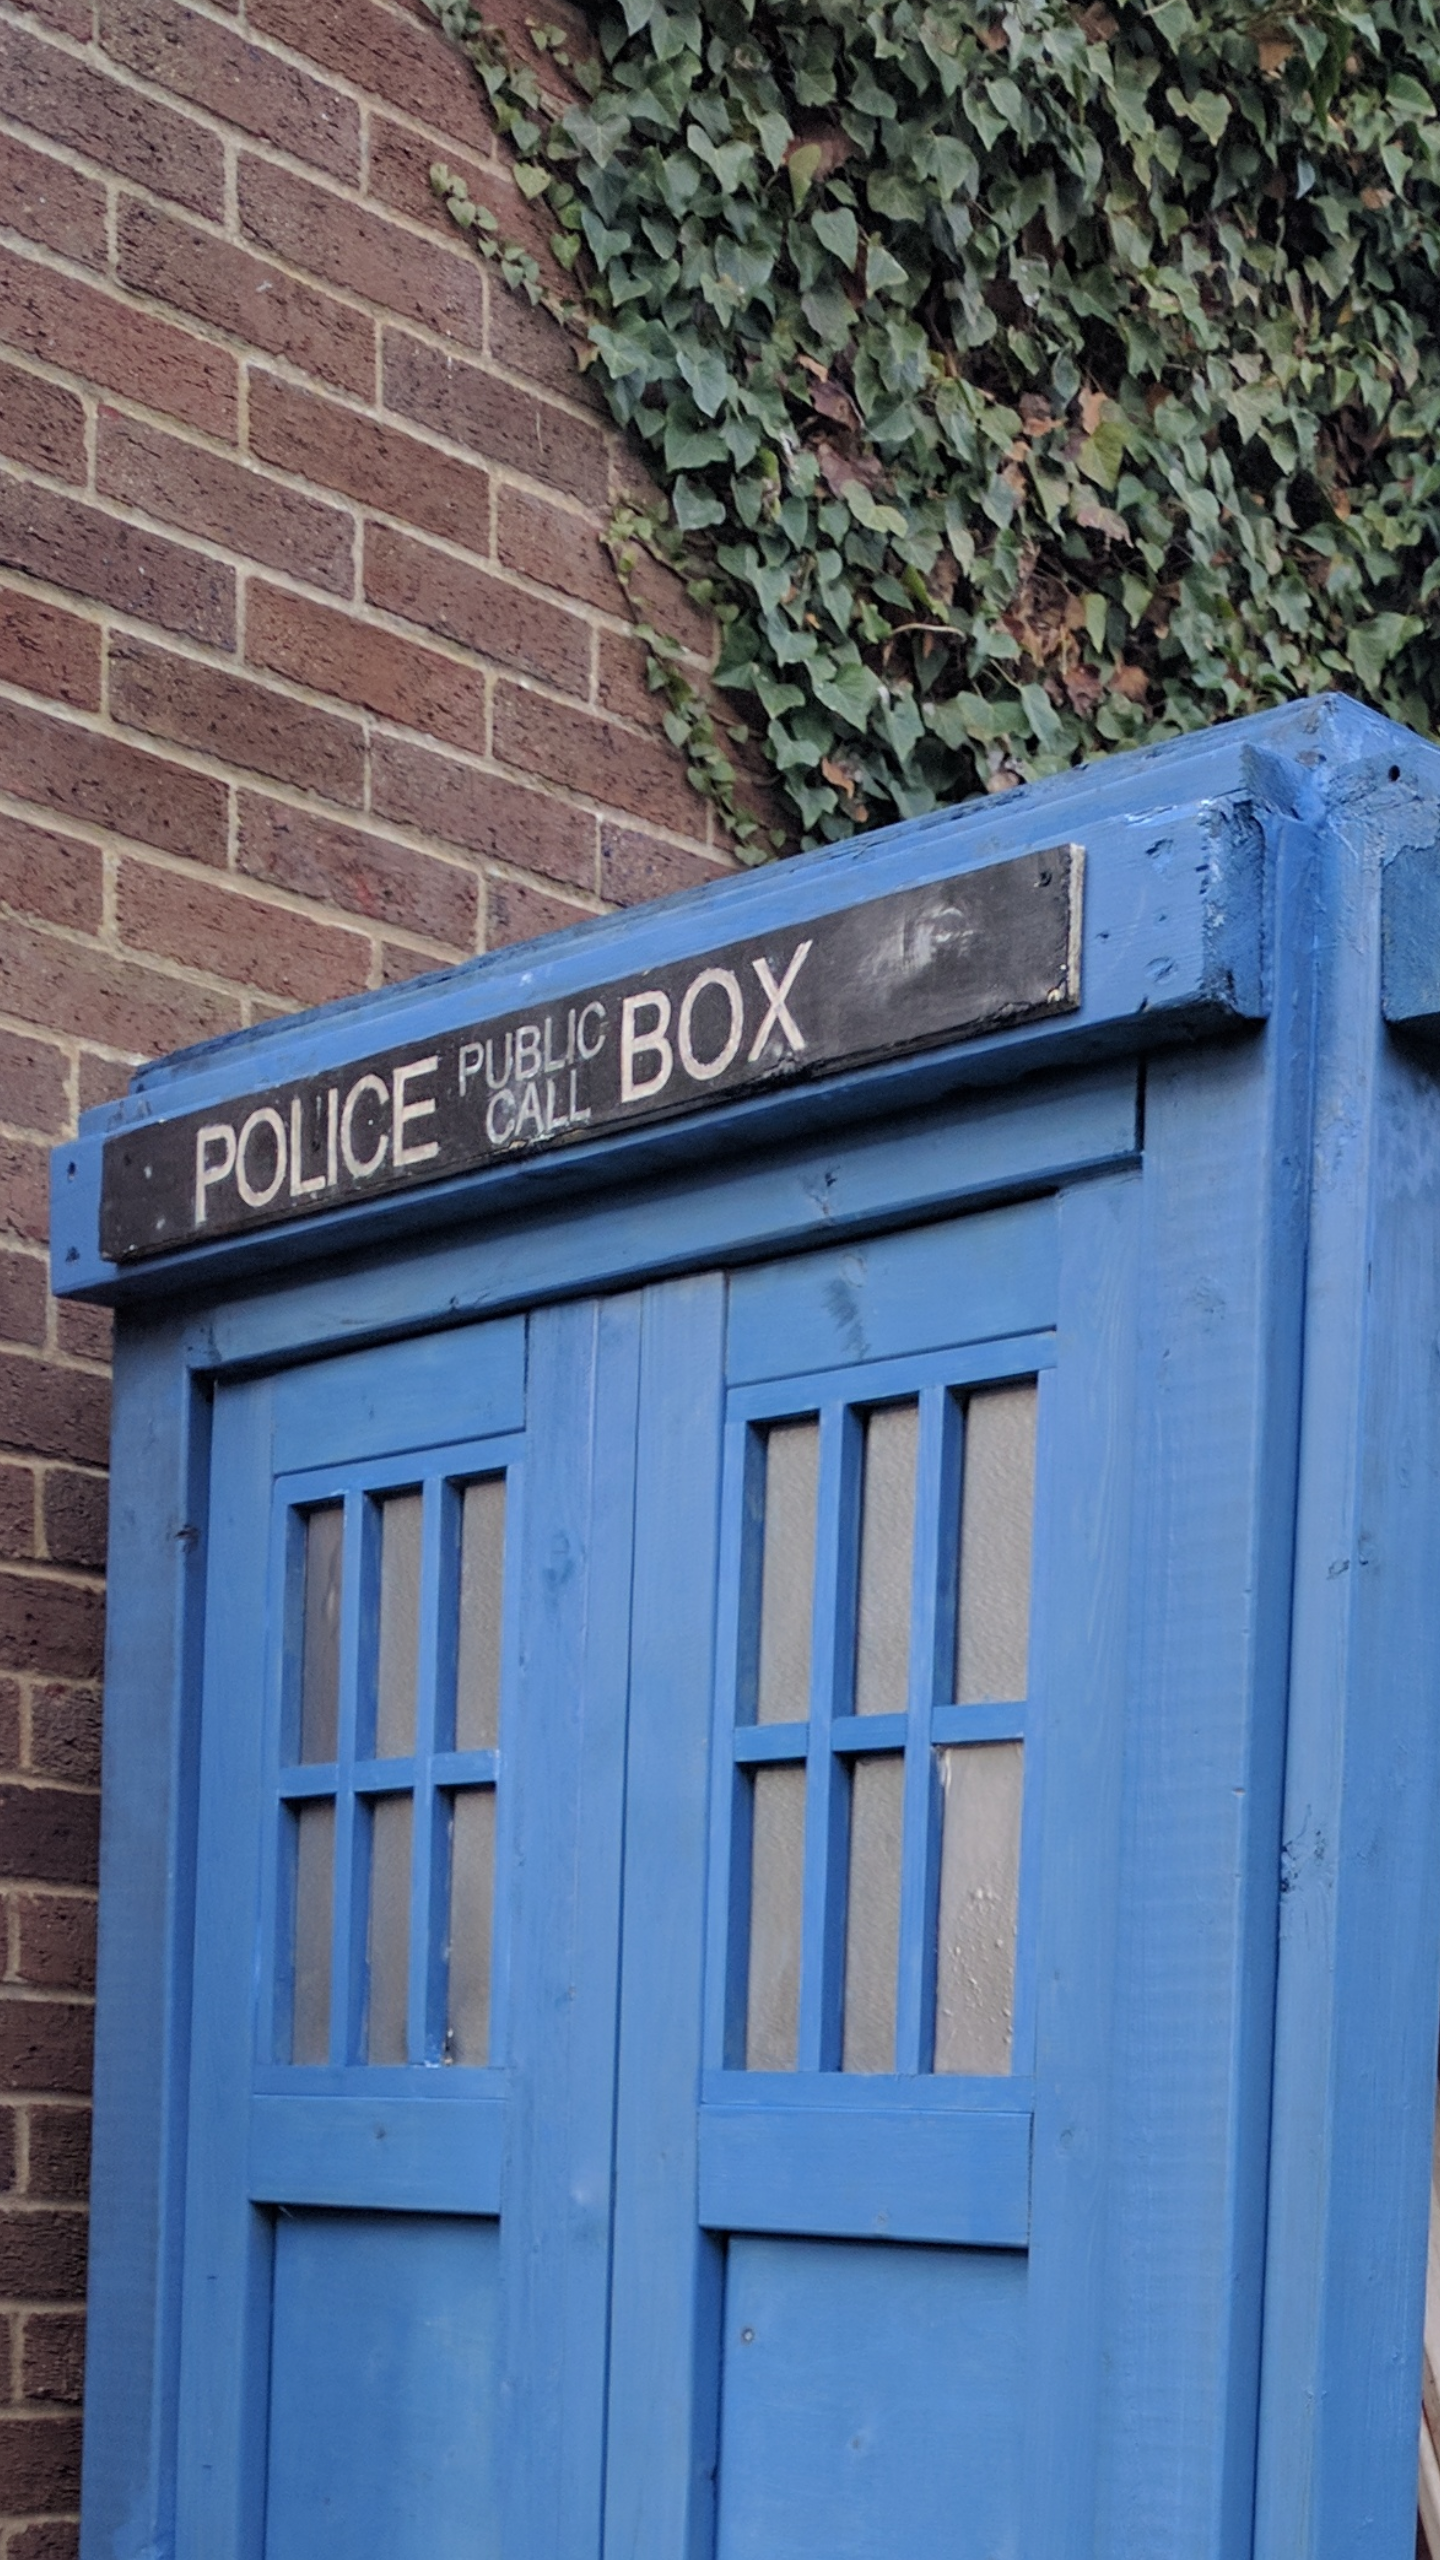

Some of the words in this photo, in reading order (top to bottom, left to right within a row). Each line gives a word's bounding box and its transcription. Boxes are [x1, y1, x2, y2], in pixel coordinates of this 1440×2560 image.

[457, 1002, 607, 1098] PUBLIC
[619, 940, 813, 1104] BOX
[194, 1057, 440, 1223] POLICE
[484, 1069, 592, 1146] CALL
